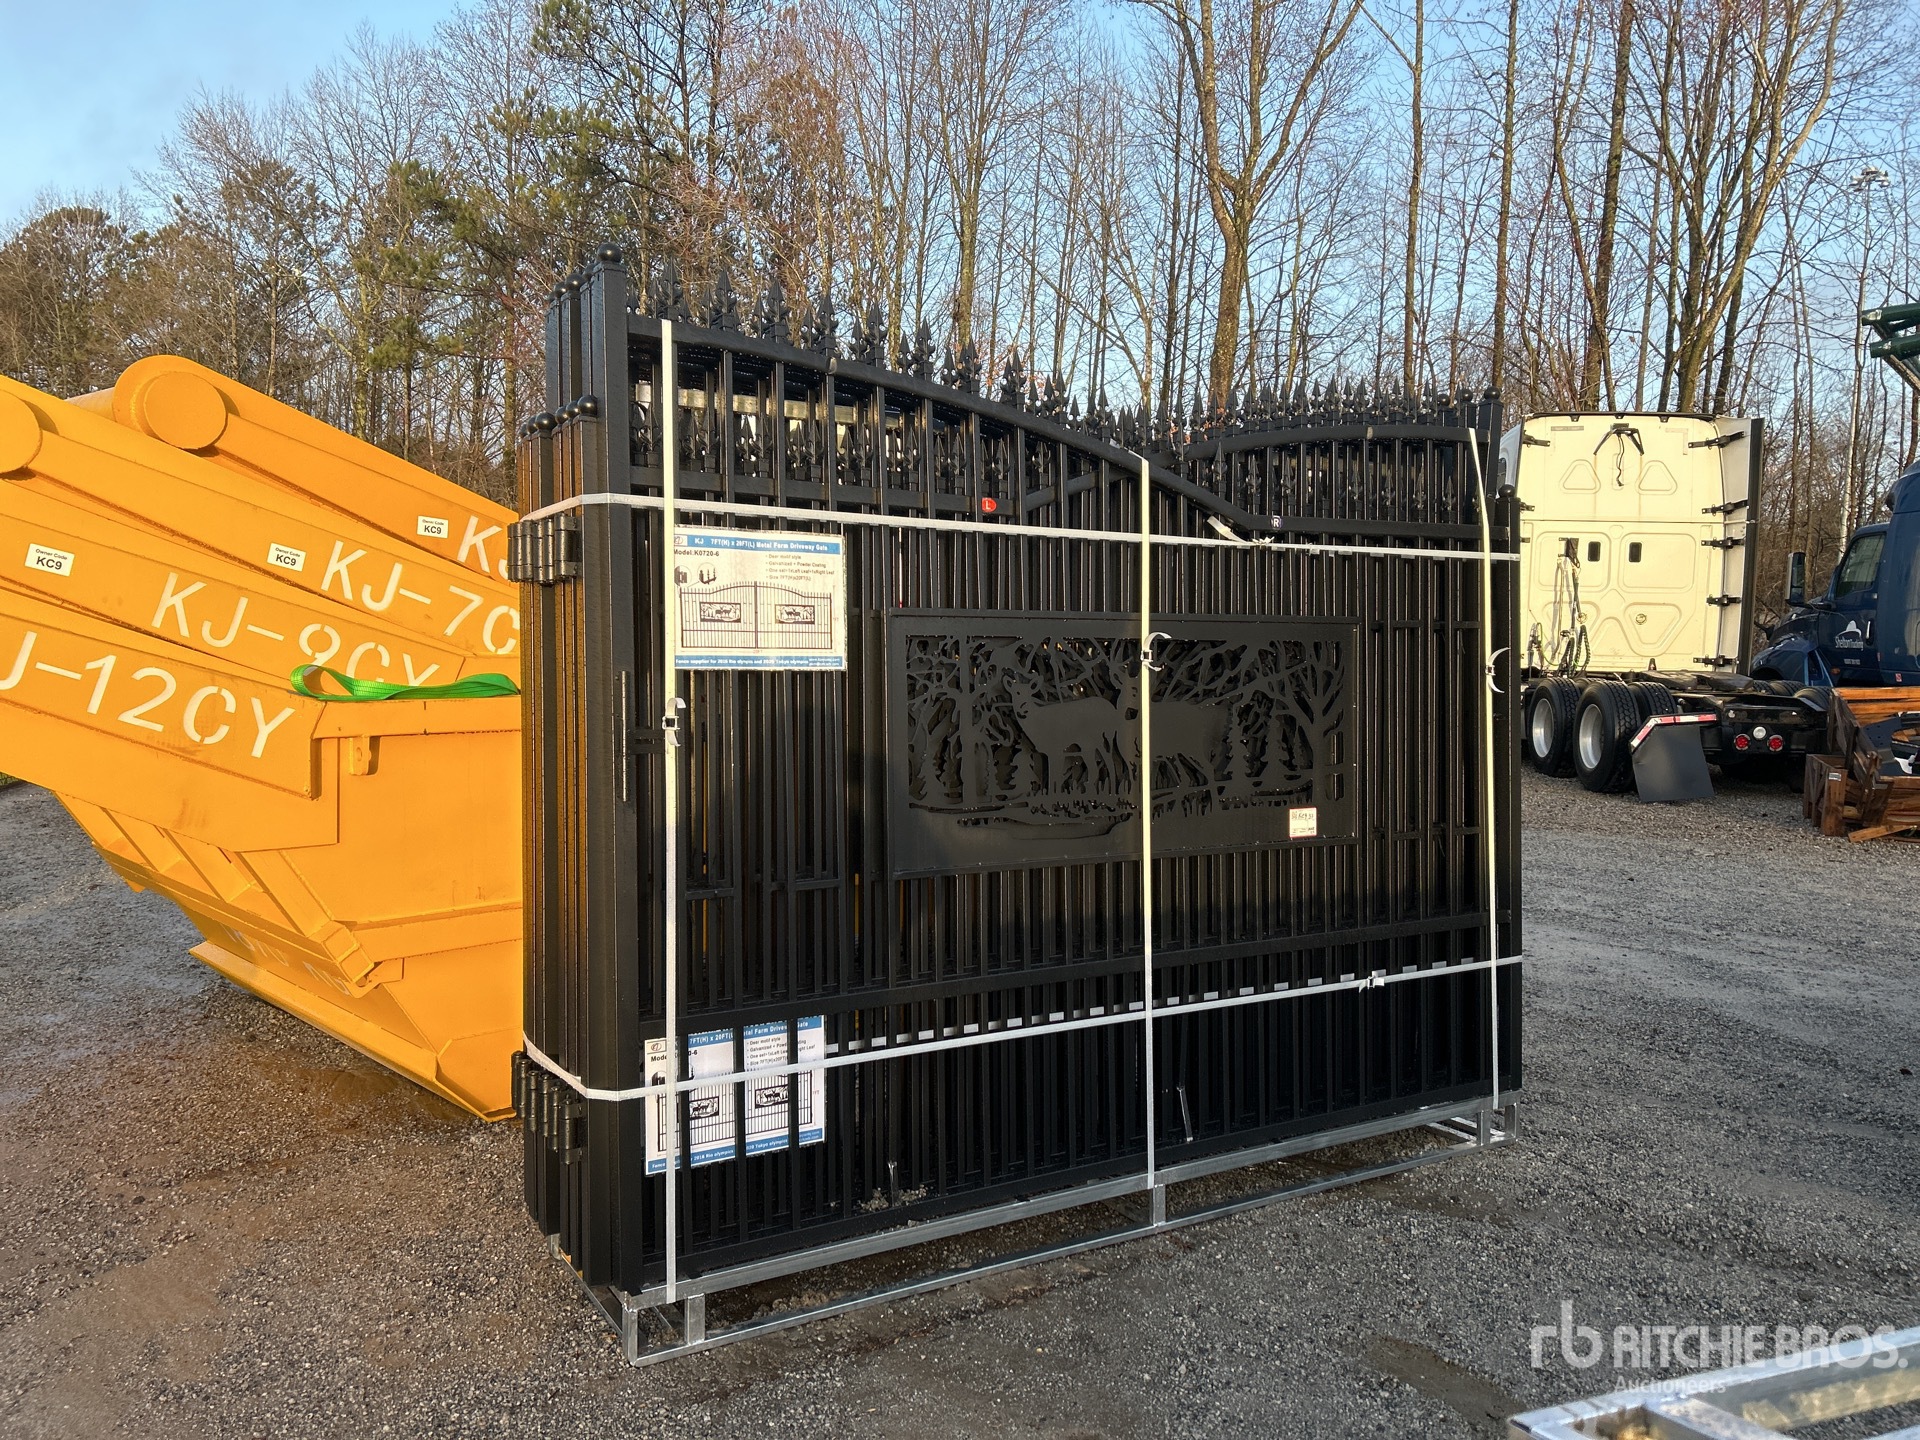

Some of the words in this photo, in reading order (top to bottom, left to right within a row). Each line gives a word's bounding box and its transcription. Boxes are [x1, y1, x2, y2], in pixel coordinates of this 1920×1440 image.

[985, 500, 991, 510] L
[1273, 518, 1280, 528] R
[424, 525, 442, 534] KC9
[710, 538, 730, 547] 7FT(H)
[790, 543, 815, 551] Driveway
[36, 556, 62, 570] KC9
[276, 554, 296, 566] KC9
